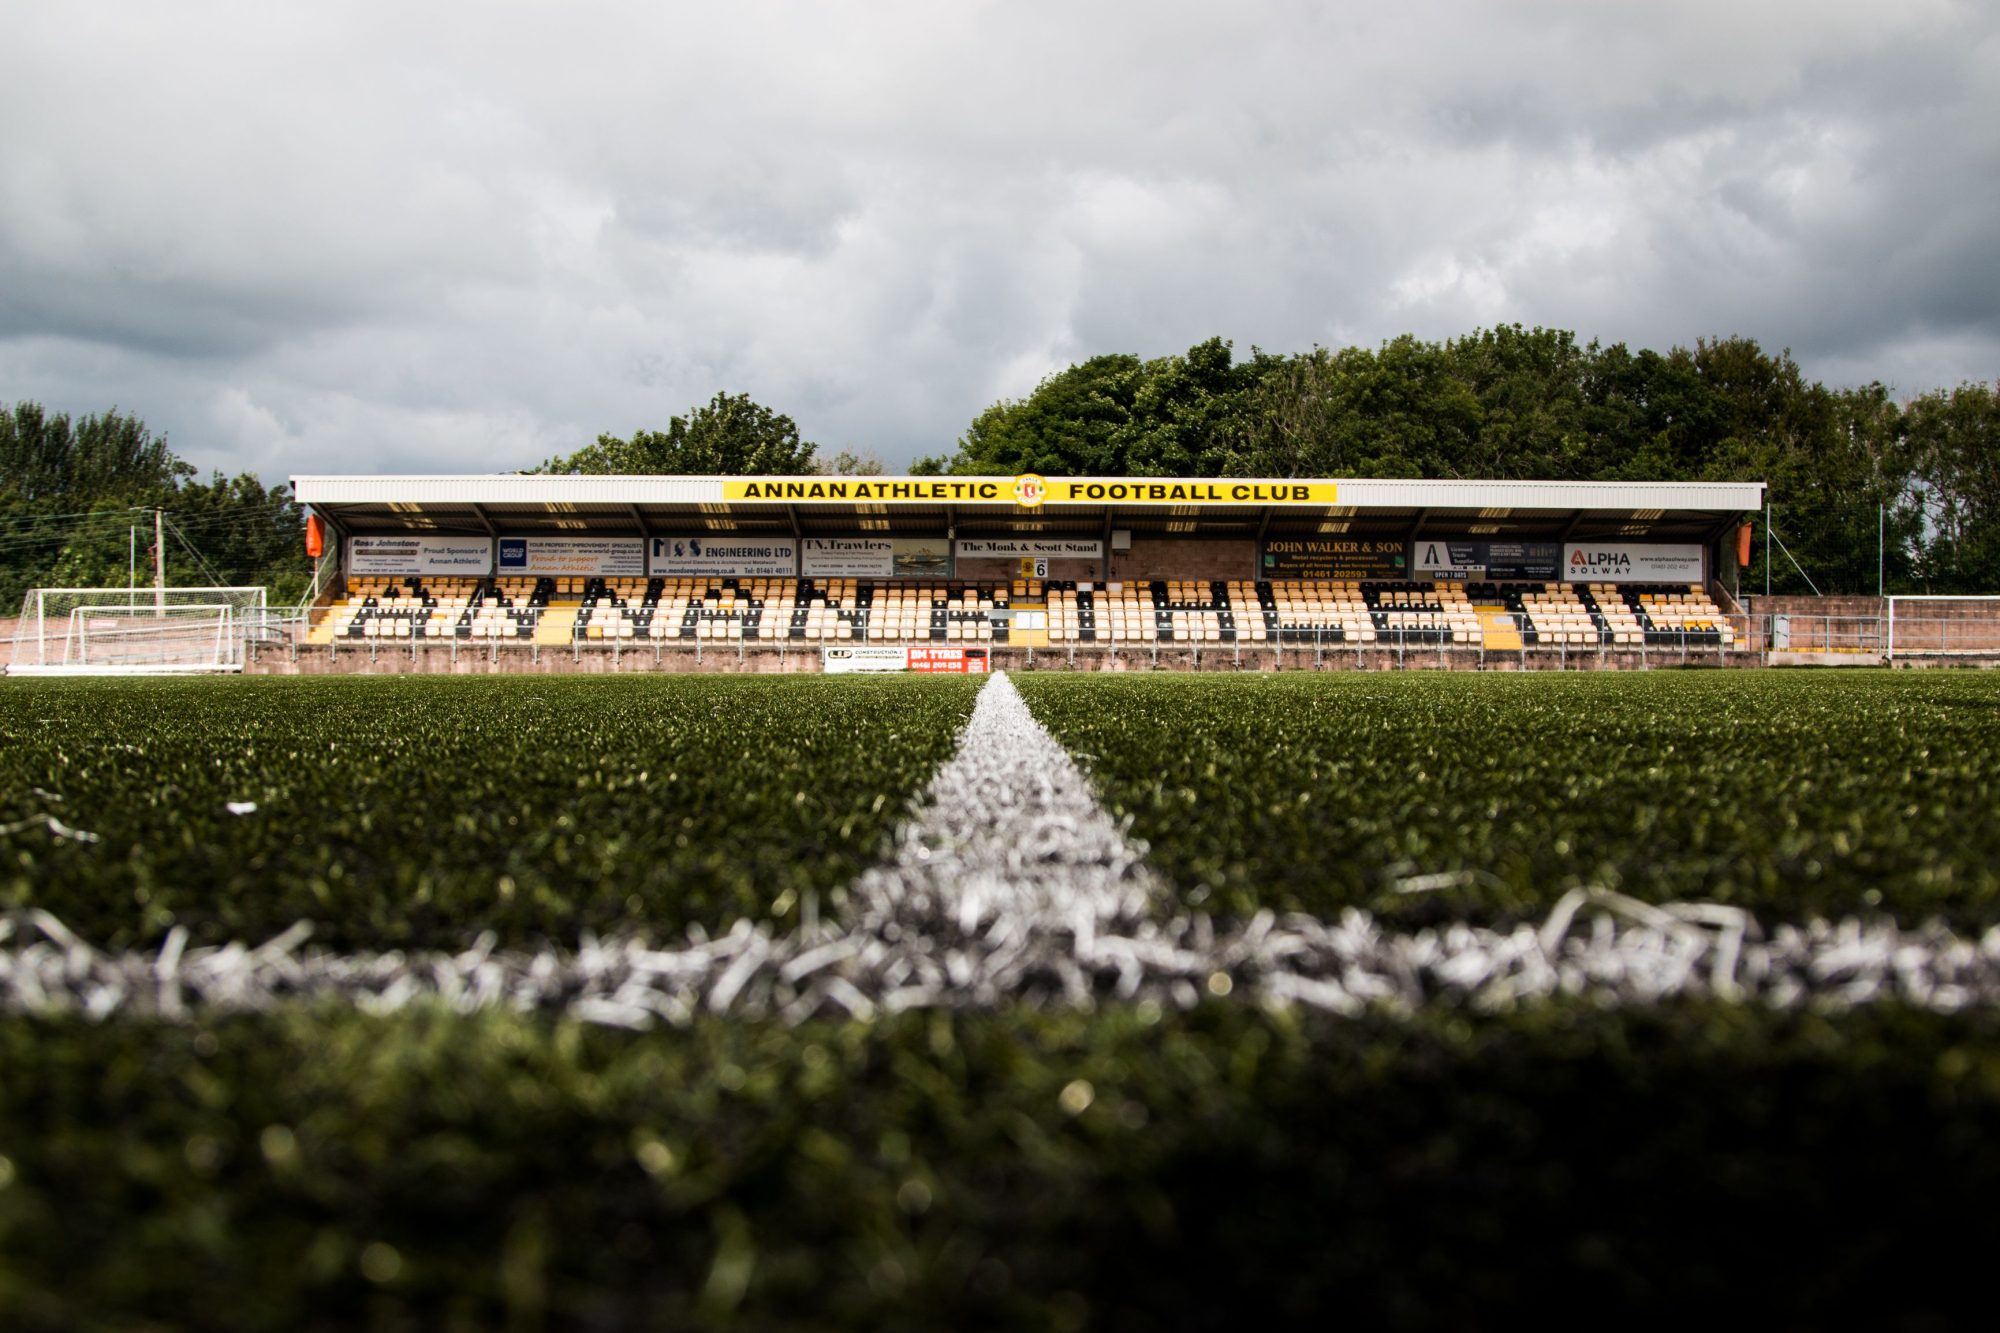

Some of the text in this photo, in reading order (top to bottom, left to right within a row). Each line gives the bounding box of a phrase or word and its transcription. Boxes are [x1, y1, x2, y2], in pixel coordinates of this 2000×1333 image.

[744, 483, 998, 498] ANNAN ATHLETIC
[1069, 484, 1310, 500] FOOTBALL CLUB
[961, 542, 1098, 552] The Monk & Scott Stand
[1267, 542, 1403, 553] JOHN WALKER & SON
[706, 548, 792, 558] ENGINEERING LTD
[1570, 549, 1630, 566] ALPHA
[1036, 564, 1046, 576] 6
[929, 650, 963, 660] TYRES
